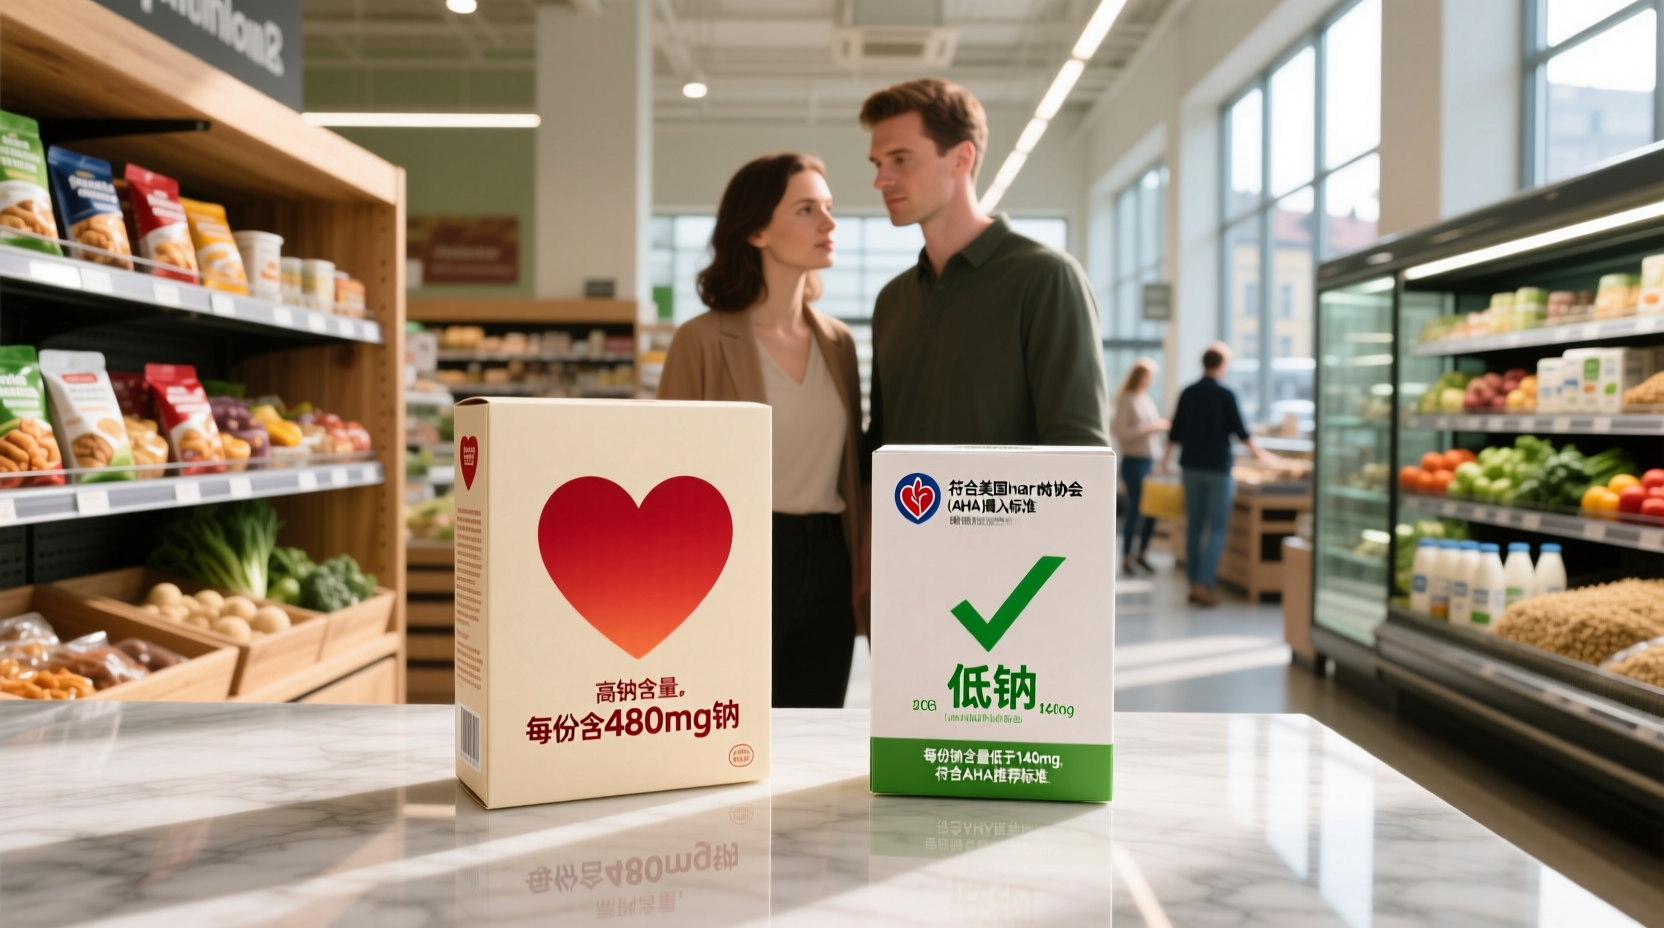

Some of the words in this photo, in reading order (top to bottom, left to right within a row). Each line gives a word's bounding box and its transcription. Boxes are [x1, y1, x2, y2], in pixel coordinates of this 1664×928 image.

[947, 663, 1037, 710] 低钠
[526, 699, 740, 744] 每份含480mg钠
